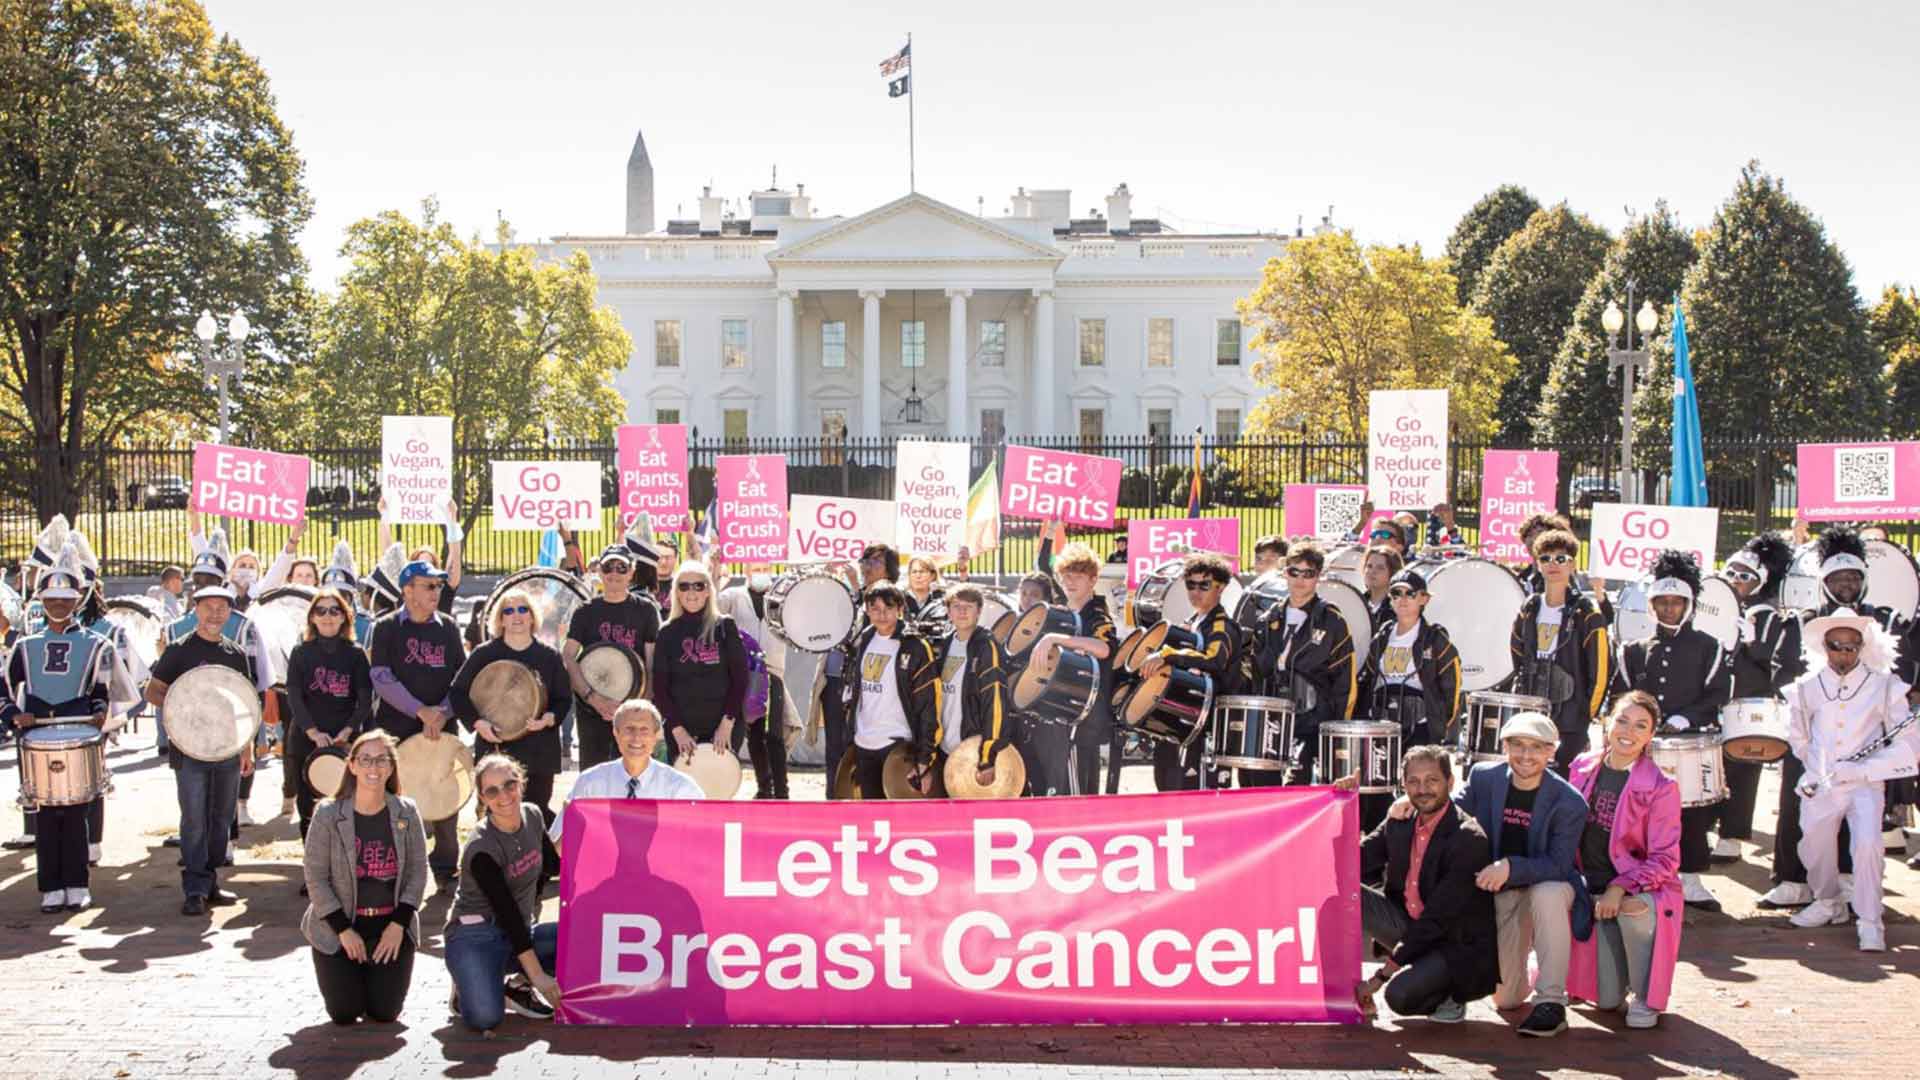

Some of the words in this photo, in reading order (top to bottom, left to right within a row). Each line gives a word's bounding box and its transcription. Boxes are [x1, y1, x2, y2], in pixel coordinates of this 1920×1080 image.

[1396, 416, 1421, 432] Go
[406, 439, 429, 454] Go
[1377, 433, 1439, 450] Vegan,
[390, 454, 444, 471] Vegan,
[639, 450, 667, 467] Eat
[1374, 456, 1442, 471] Reduce
[216, 452, 266, 485] Eat
[921, 466, 945, 481] Go
[1026, 455, 1078, 487] Eat
[388, 474, 447, 489] Reduce
[519, 467, 561, 492] Go
[624, 470, 683, 488] Plants,
[1386, 473, 1429, 488] Your
[1504, 477, 1535, 495] Eat
[738, 480, 767, 497] Eat
[904, 481, 960, 500] Vegan,
[200, 480, 298, 520] Plants
[398, 491, 436, 504] Your
[627, 491, 680, 508] Crush
[1008, 484, 1109, 521] Plants
[1389, 490, 1426, 506] Risk
[401, 506, 433, 520] Risk
[500, 494, 592, 526] Vegan
[723, 502, 783, 520] Plants,
[816, 503, 857, 530] Go
[901, 503, 962, 520] Reduce
[624, 511, 686, 528] Cncer
[911, 521, 951, 535] Your
[1489, 519, 1521, 536] Cru
[1622, 510, 1669, 539] Go
[727, 522, 780, 538] Crush
[796, 529, 872, 561] Vega
[913, 537, 947, 552] Risk
[1149, 526, 1197, 552] Eat
[723, 542, 786, 558] Cancer
[1482, 540, 1530, 557] Canc
[43, 640, 72, 675] E
[1383, 646, 1413, 674] W
[863, 652, 892, 682] W
[363, 847, 396, 863] BEA
[723, 819, 940, 897] Let's
[973, 817, 1197, 893] Beat
[601, 913, 912, 991] Breast
[941, 906, 1320, 989] Cancer!
